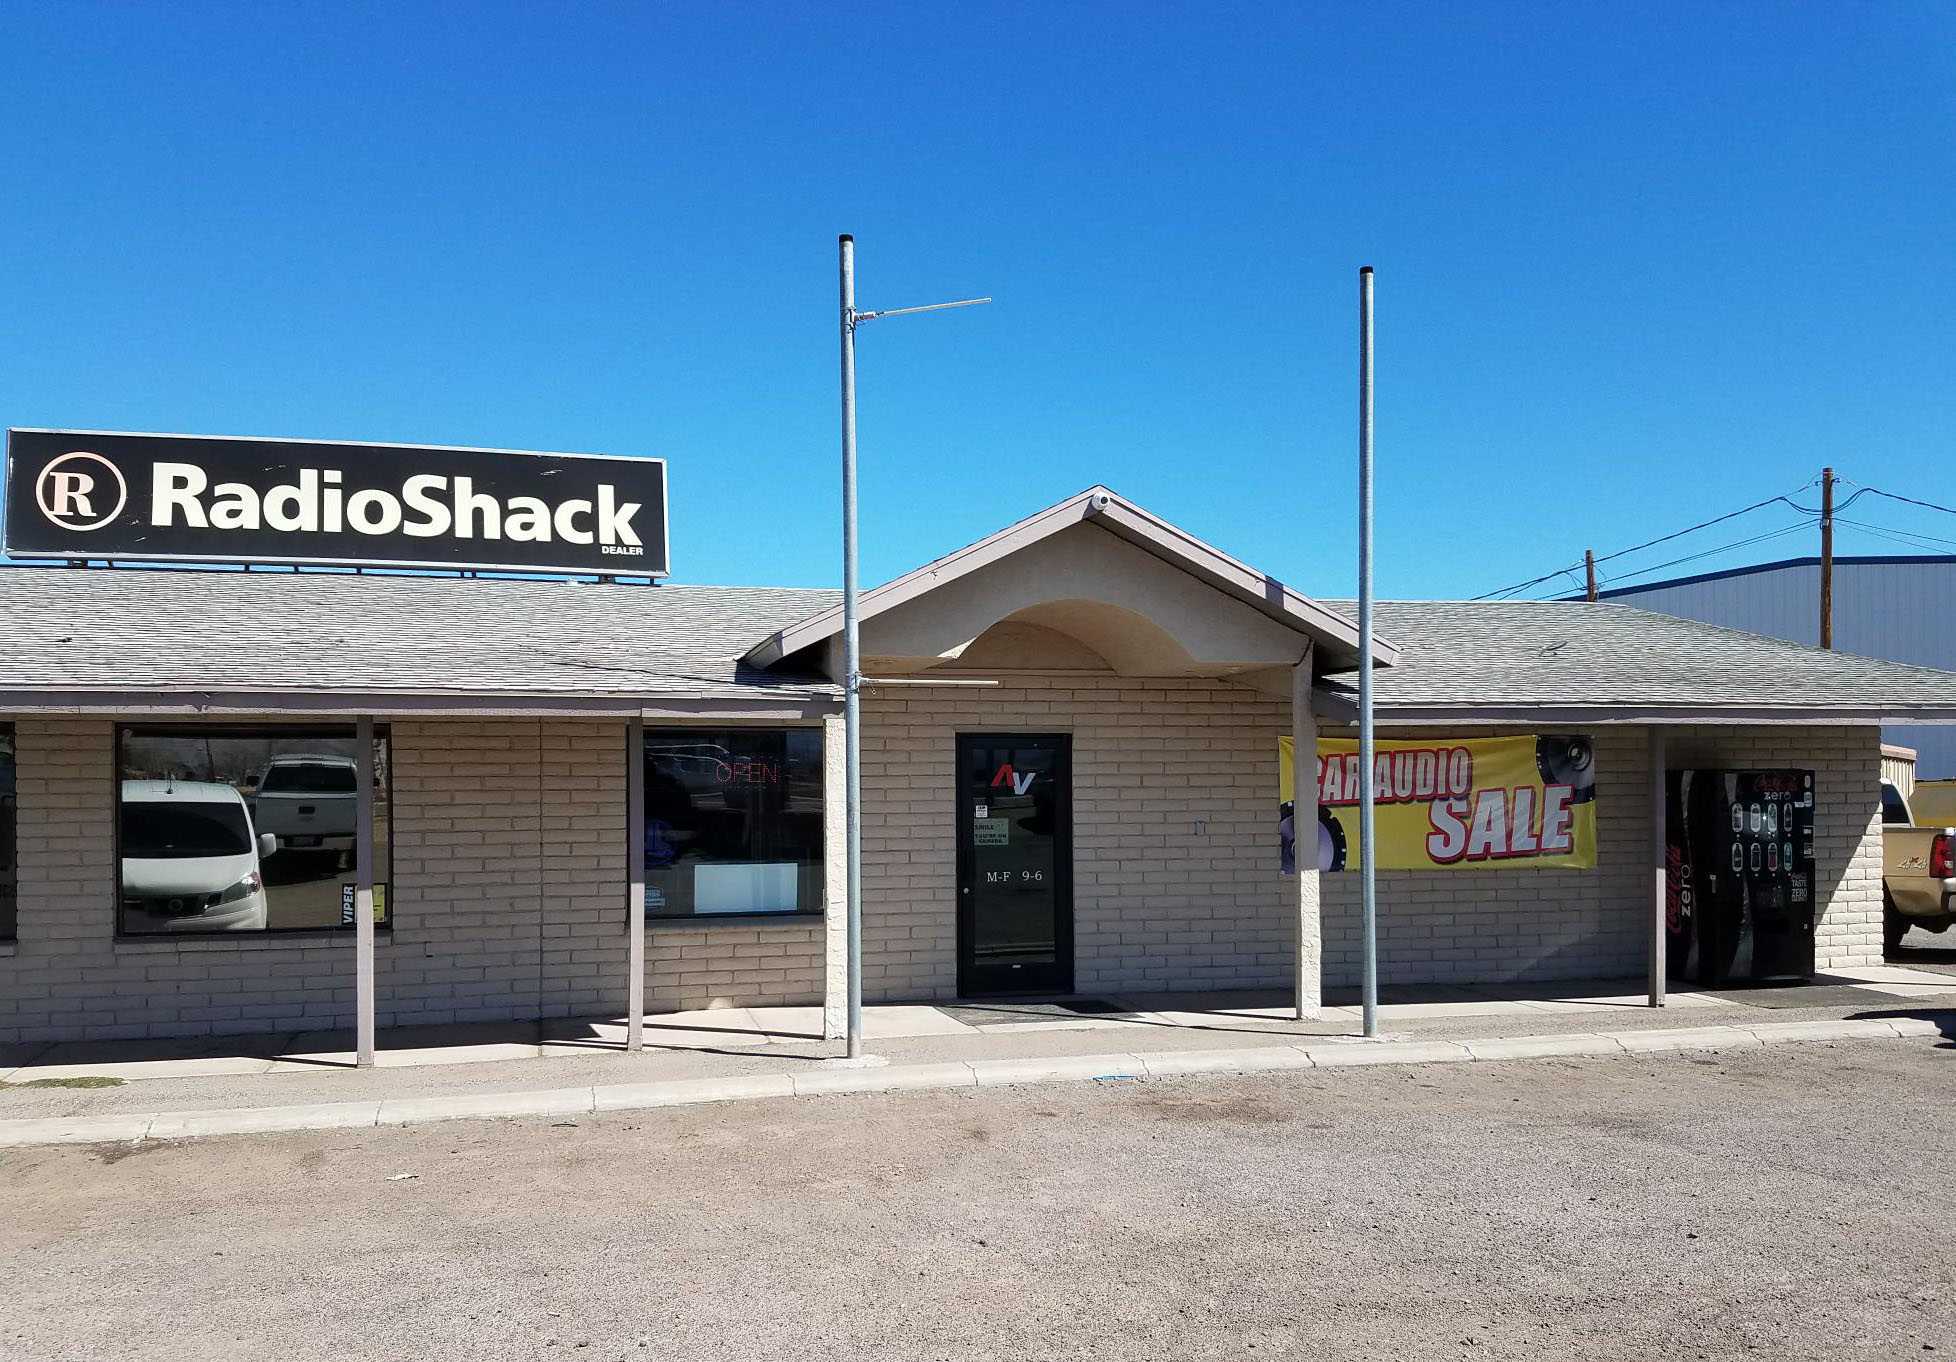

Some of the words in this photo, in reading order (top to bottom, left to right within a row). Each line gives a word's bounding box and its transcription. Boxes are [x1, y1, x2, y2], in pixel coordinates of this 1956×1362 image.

[152, 461, 643, 546] RadioShack
[601, 546, 643, 555] DEALER
[716, 763, 777, 783] OPEN
[1374, 748, 1471, 799] AUDIO
[1763, 790, 1791, 801] zero
[1428, 785, 1574, 858] SALE
[986, 871, 1011, 882] M-F
[1022, 870, 1043, 881] 9-6
[1681, 864, 1691, 916] zero
[343, 886, 354, 924] VIPER
